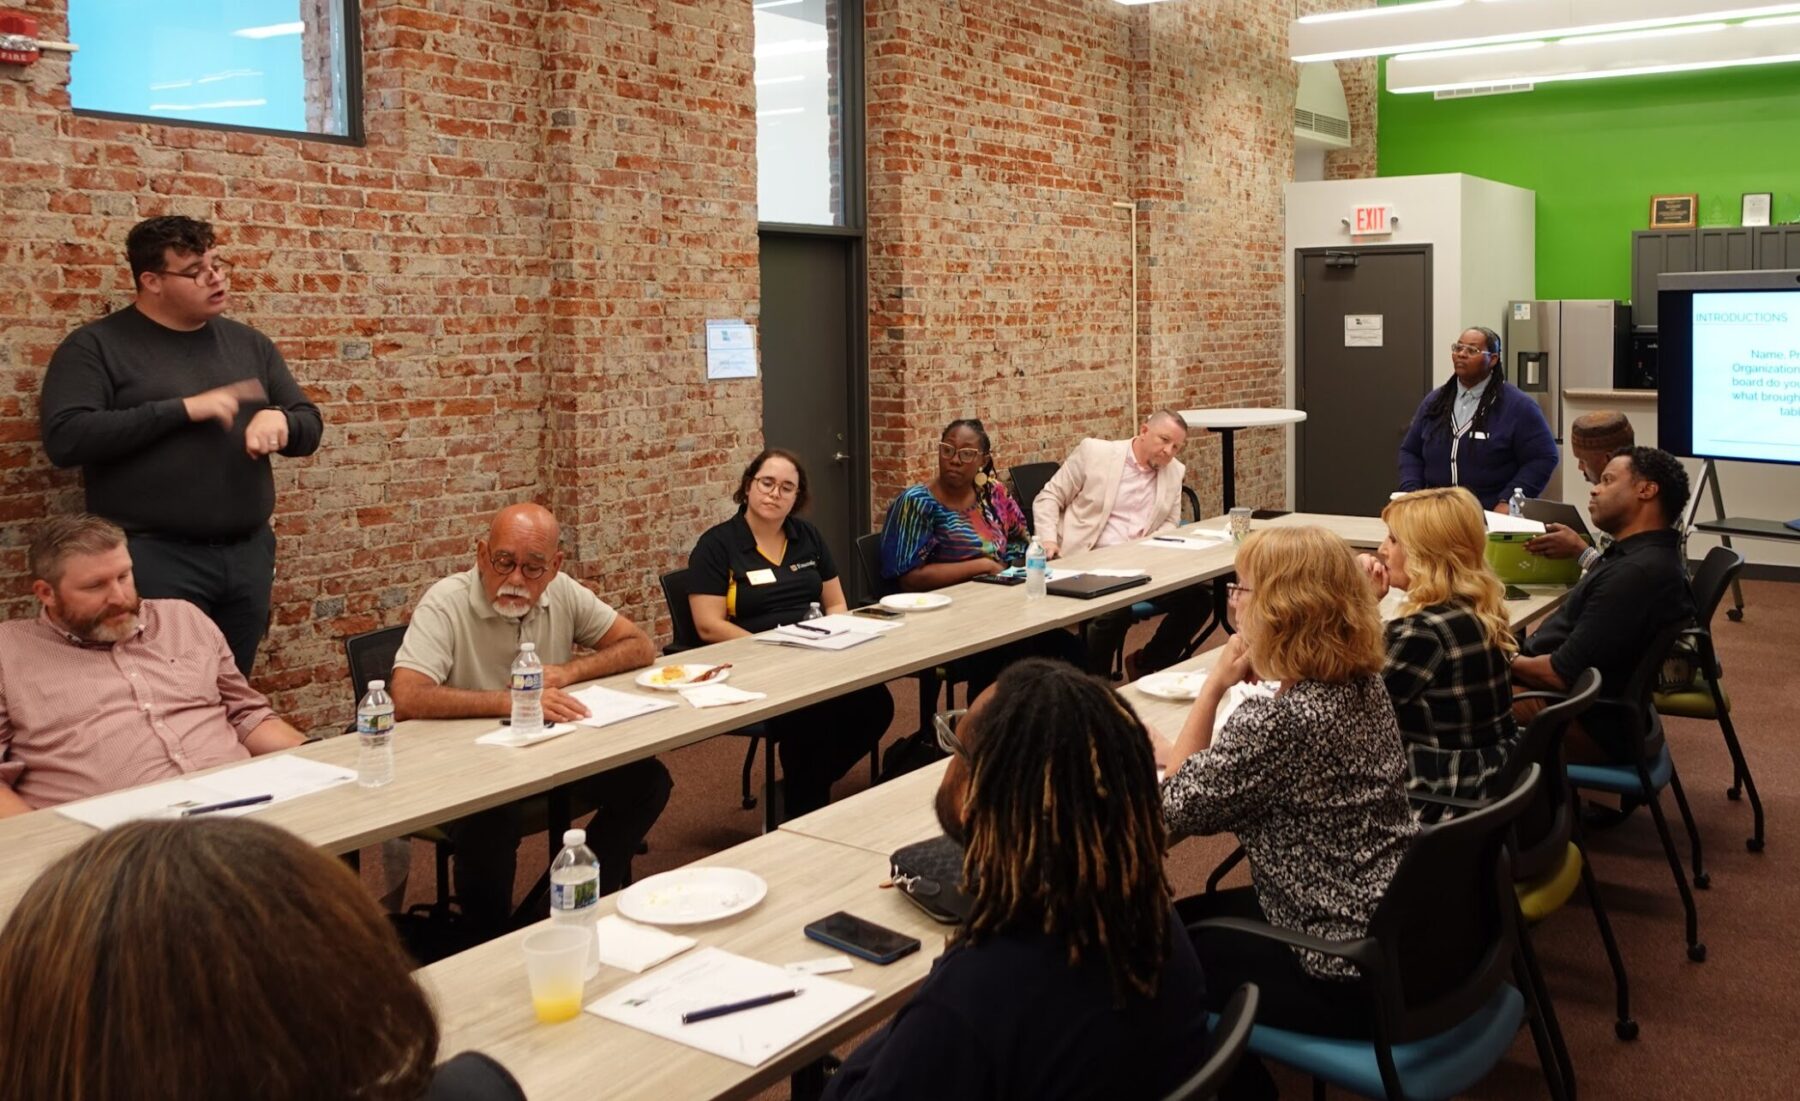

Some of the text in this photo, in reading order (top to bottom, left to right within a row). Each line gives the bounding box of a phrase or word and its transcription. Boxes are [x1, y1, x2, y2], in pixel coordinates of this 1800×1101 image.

[1357, 207, 1385, 231] EXIT
[1695, 312, 1788, 323] INTRODUCTIONS
[1732, 363, 1800, 374] Organization
[1732, 377, 1764, 387] board
[1766, 378, 1780, 388] do
[1732, 391, 1800, 404] what brough
